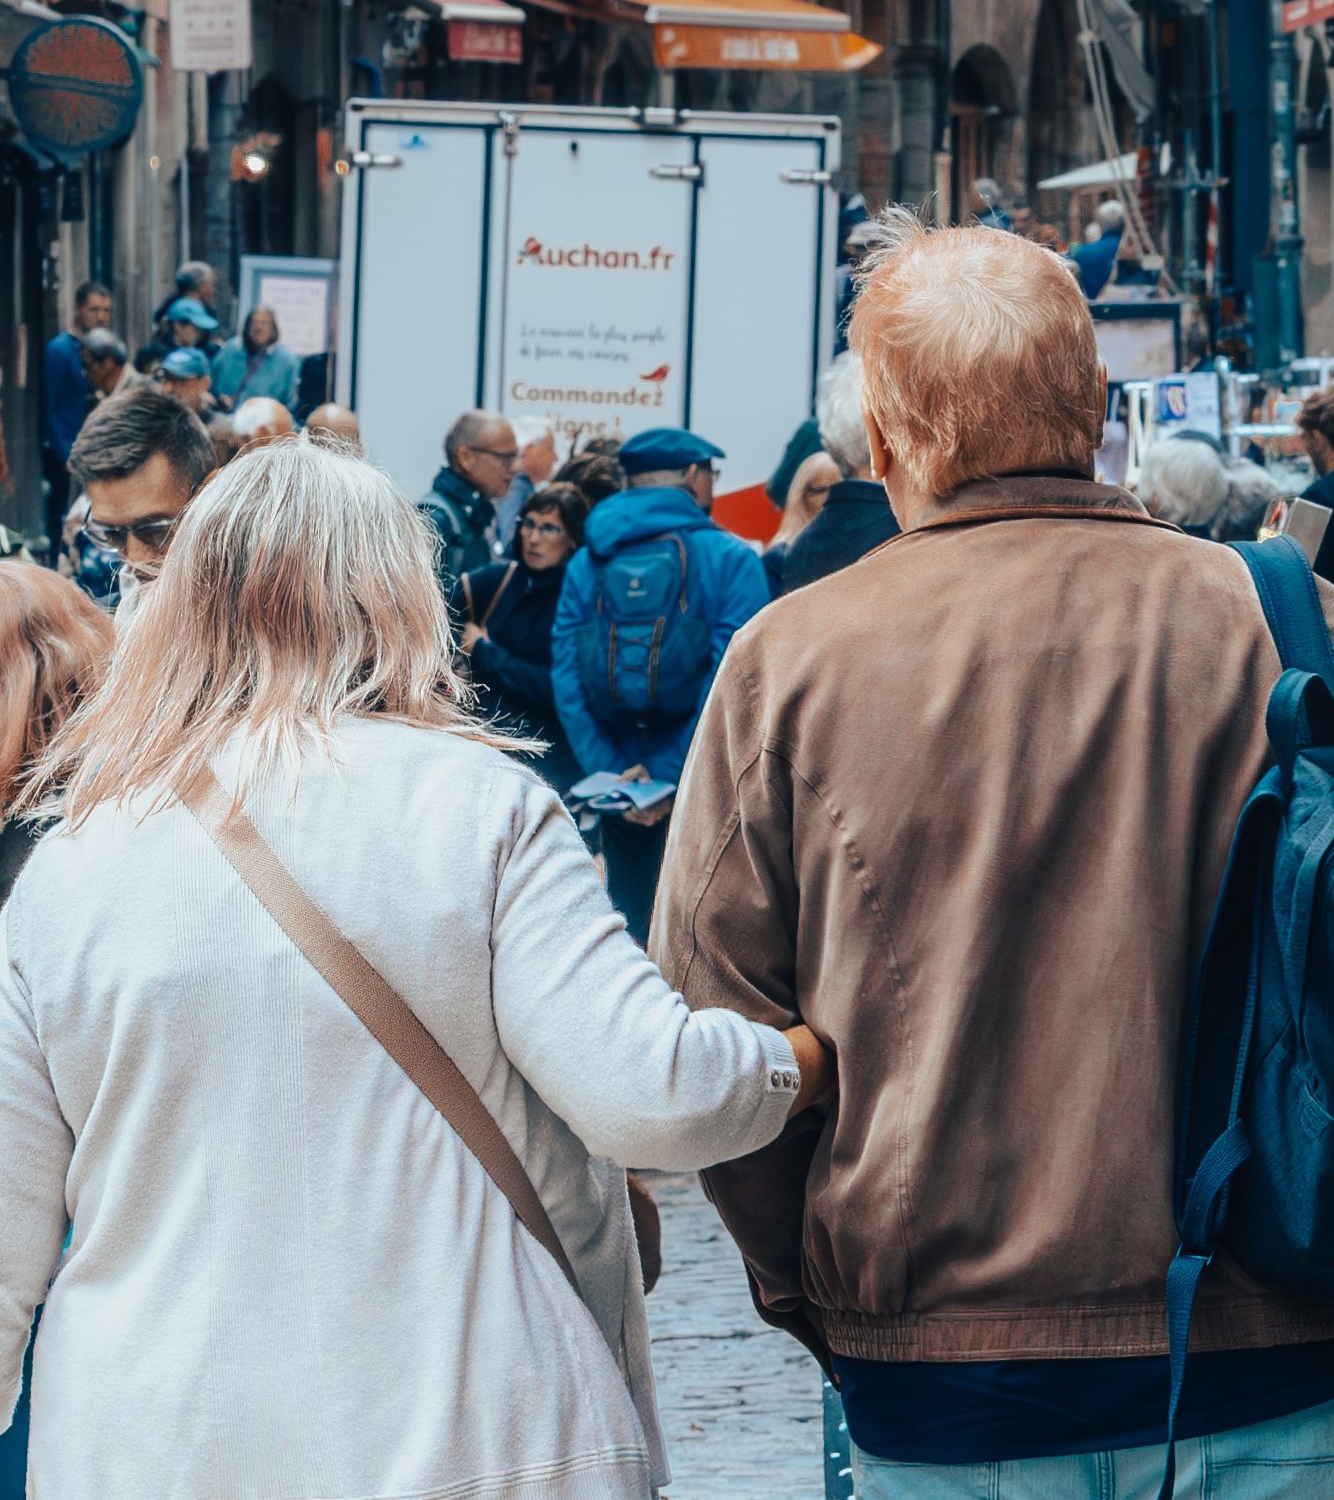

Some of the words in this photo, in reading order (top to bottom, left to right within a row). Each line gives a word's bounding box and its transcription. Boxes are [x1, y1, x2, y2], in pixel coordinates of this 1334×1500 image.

[516, 236, 675, 271] Auchan.fr
[510, 380, 664, 408] Commandez
[549, 413, 607, 440] igne
